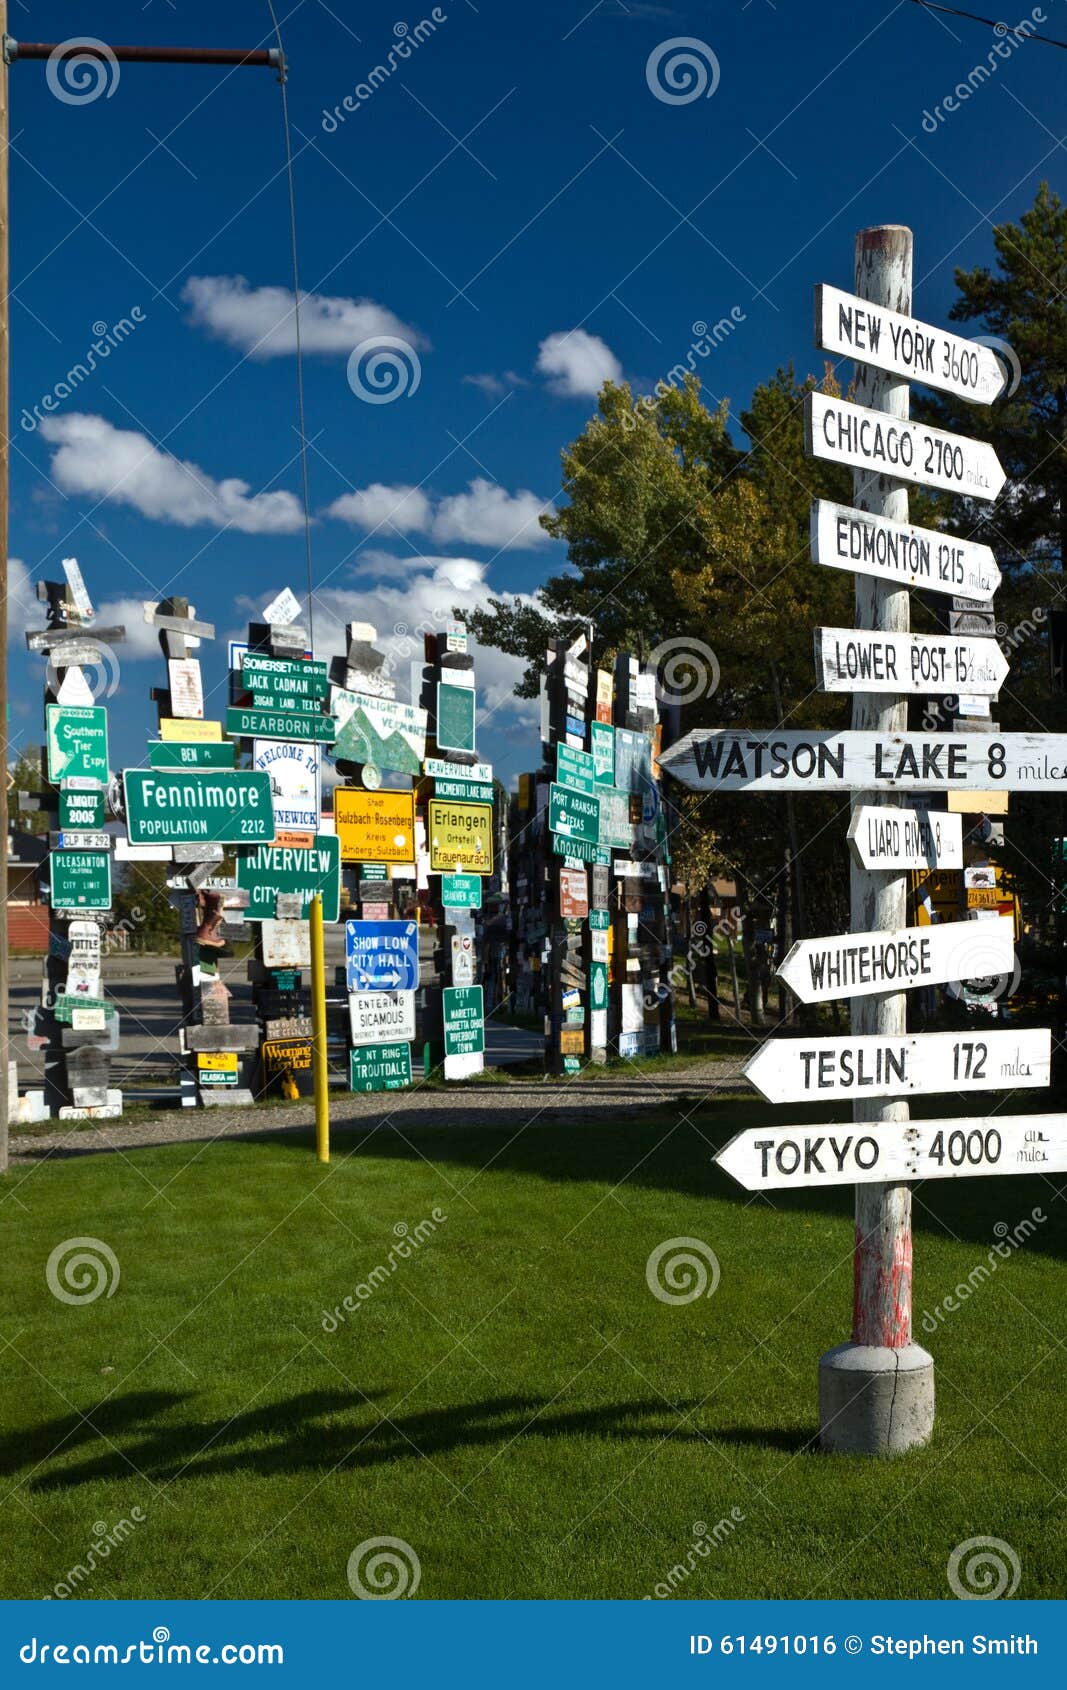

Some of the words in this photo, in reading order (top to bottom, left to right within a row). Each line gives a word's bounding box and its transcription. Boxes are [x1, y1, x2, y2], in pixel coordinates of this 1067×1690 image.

[838, 303, 881, 354] NEW
[890, 322, 935, 374] YORK
[943, 340, 979, 389] 3600
[822, 409, 914, 467] CHICAGO
[924, 436, 964, 481] 2700
[836, 517, 931, 577] EDMONTON
[938, 544, 965, 585] 1215
[969, 562, 992, 591] miles
[243, 658, 293, 673] SOMERSET
[835, 641, 898, 681] LOWER
[247, 674, 269, 689] JACK
[273, 677, 308, 693] CADMAN
[254, 695, 274, 707] SUGAR
[302, 700, 320, 711] TEXAS
[338, 691, 398, 712] MOONLIGHT
[404, 708, 415, 719] IN
[63, 725, 104, 739] Southern
[241, 715, 310, 735] DEARBORN
[73, 740, 92, 753] Tier
[83, 754, 105, 768] Expy
[181, 748, 198, 762] BEN
[257, 745, 304, 769] WELCOME
[305, 757, 318, 774] TO
[692, 742, 845, 779] WATSON
[874, 742, 967, 779] LAKE
[987, 742, 1007, 779] 8
[428, 760, 473, 778] WEAVERVILLE
[480, 767, 489, 779] NC
[141, 780, 259, 807] Fennimore
[466, 784, 480, 798] LAKE
[66, 796, 99, 807] AMQUI
[367, 798, 385, 807] Stadt
[553, 791, 568, 807] PORT
[570, 798, 598, 817] ARANSAS
[69, 811, 95, 823] 2005
[338, 810, 412, 829] Sulzbach-Rosenberg
[434, 810, 487, 831] Erlangen
[566, 814, 585, 831] TEXAS
[140, 820, 208, 834] POPULATION
[241, 820, 265, 834] 2212
[366, 832, 386, 842] Kreis
[447, 834, 476, 844] Ortsteil
[868, 818, 900, 857] LIARD
[905, 820, 933, 858] RIVER
[936, 820, 942, 859] 8
[342, 845, 410, 857] Amberg-Sulzbach
[433, 848, 490, 865] Frauenaurach
[553, 834, 597, 863] Knoxville
[56, 856, 105, 868] PLEASANTON
[247, 846, 331, 873] RIVERVIEW
[63, 881, 76, 889] CITY
[83, 881, 100, 889] LIMIT
[353, 937, 379, 949] SHOW
[384, 937, 409, 949] LOW
[352, 955, 373, 967] CITY
[379, 954, 411, 967] HALL
[808, 938, 932, 991] WHITEHORSE
[455, 989, 469, 999] CITY
[358, 997, 404, 1010] ENTERING
[360, 1011, 404, 1027] SICAMOUS
[450, 1008, 477, 1019] MARIETTA
[450, 1030, 478, 1042] RIVERBOAT
[266, 1044, 311, 1059] Wyoming
[457, 1043, 473, 1053] TOWN
[292, 1057, 312, 1069] Tour
[356, 1061, 407, 1078] TROUTDALE
[799, 1048, 906, 1089] TESLIN
[953, 1043, 988, 1080] 172
[1000, 1047, 1033, 1077] miles
[754, 1136, 880, 1178] TOKYO
[928, 1129, 1001, 1166] 4000
[1016, 1146, 1050, 1164] miles
